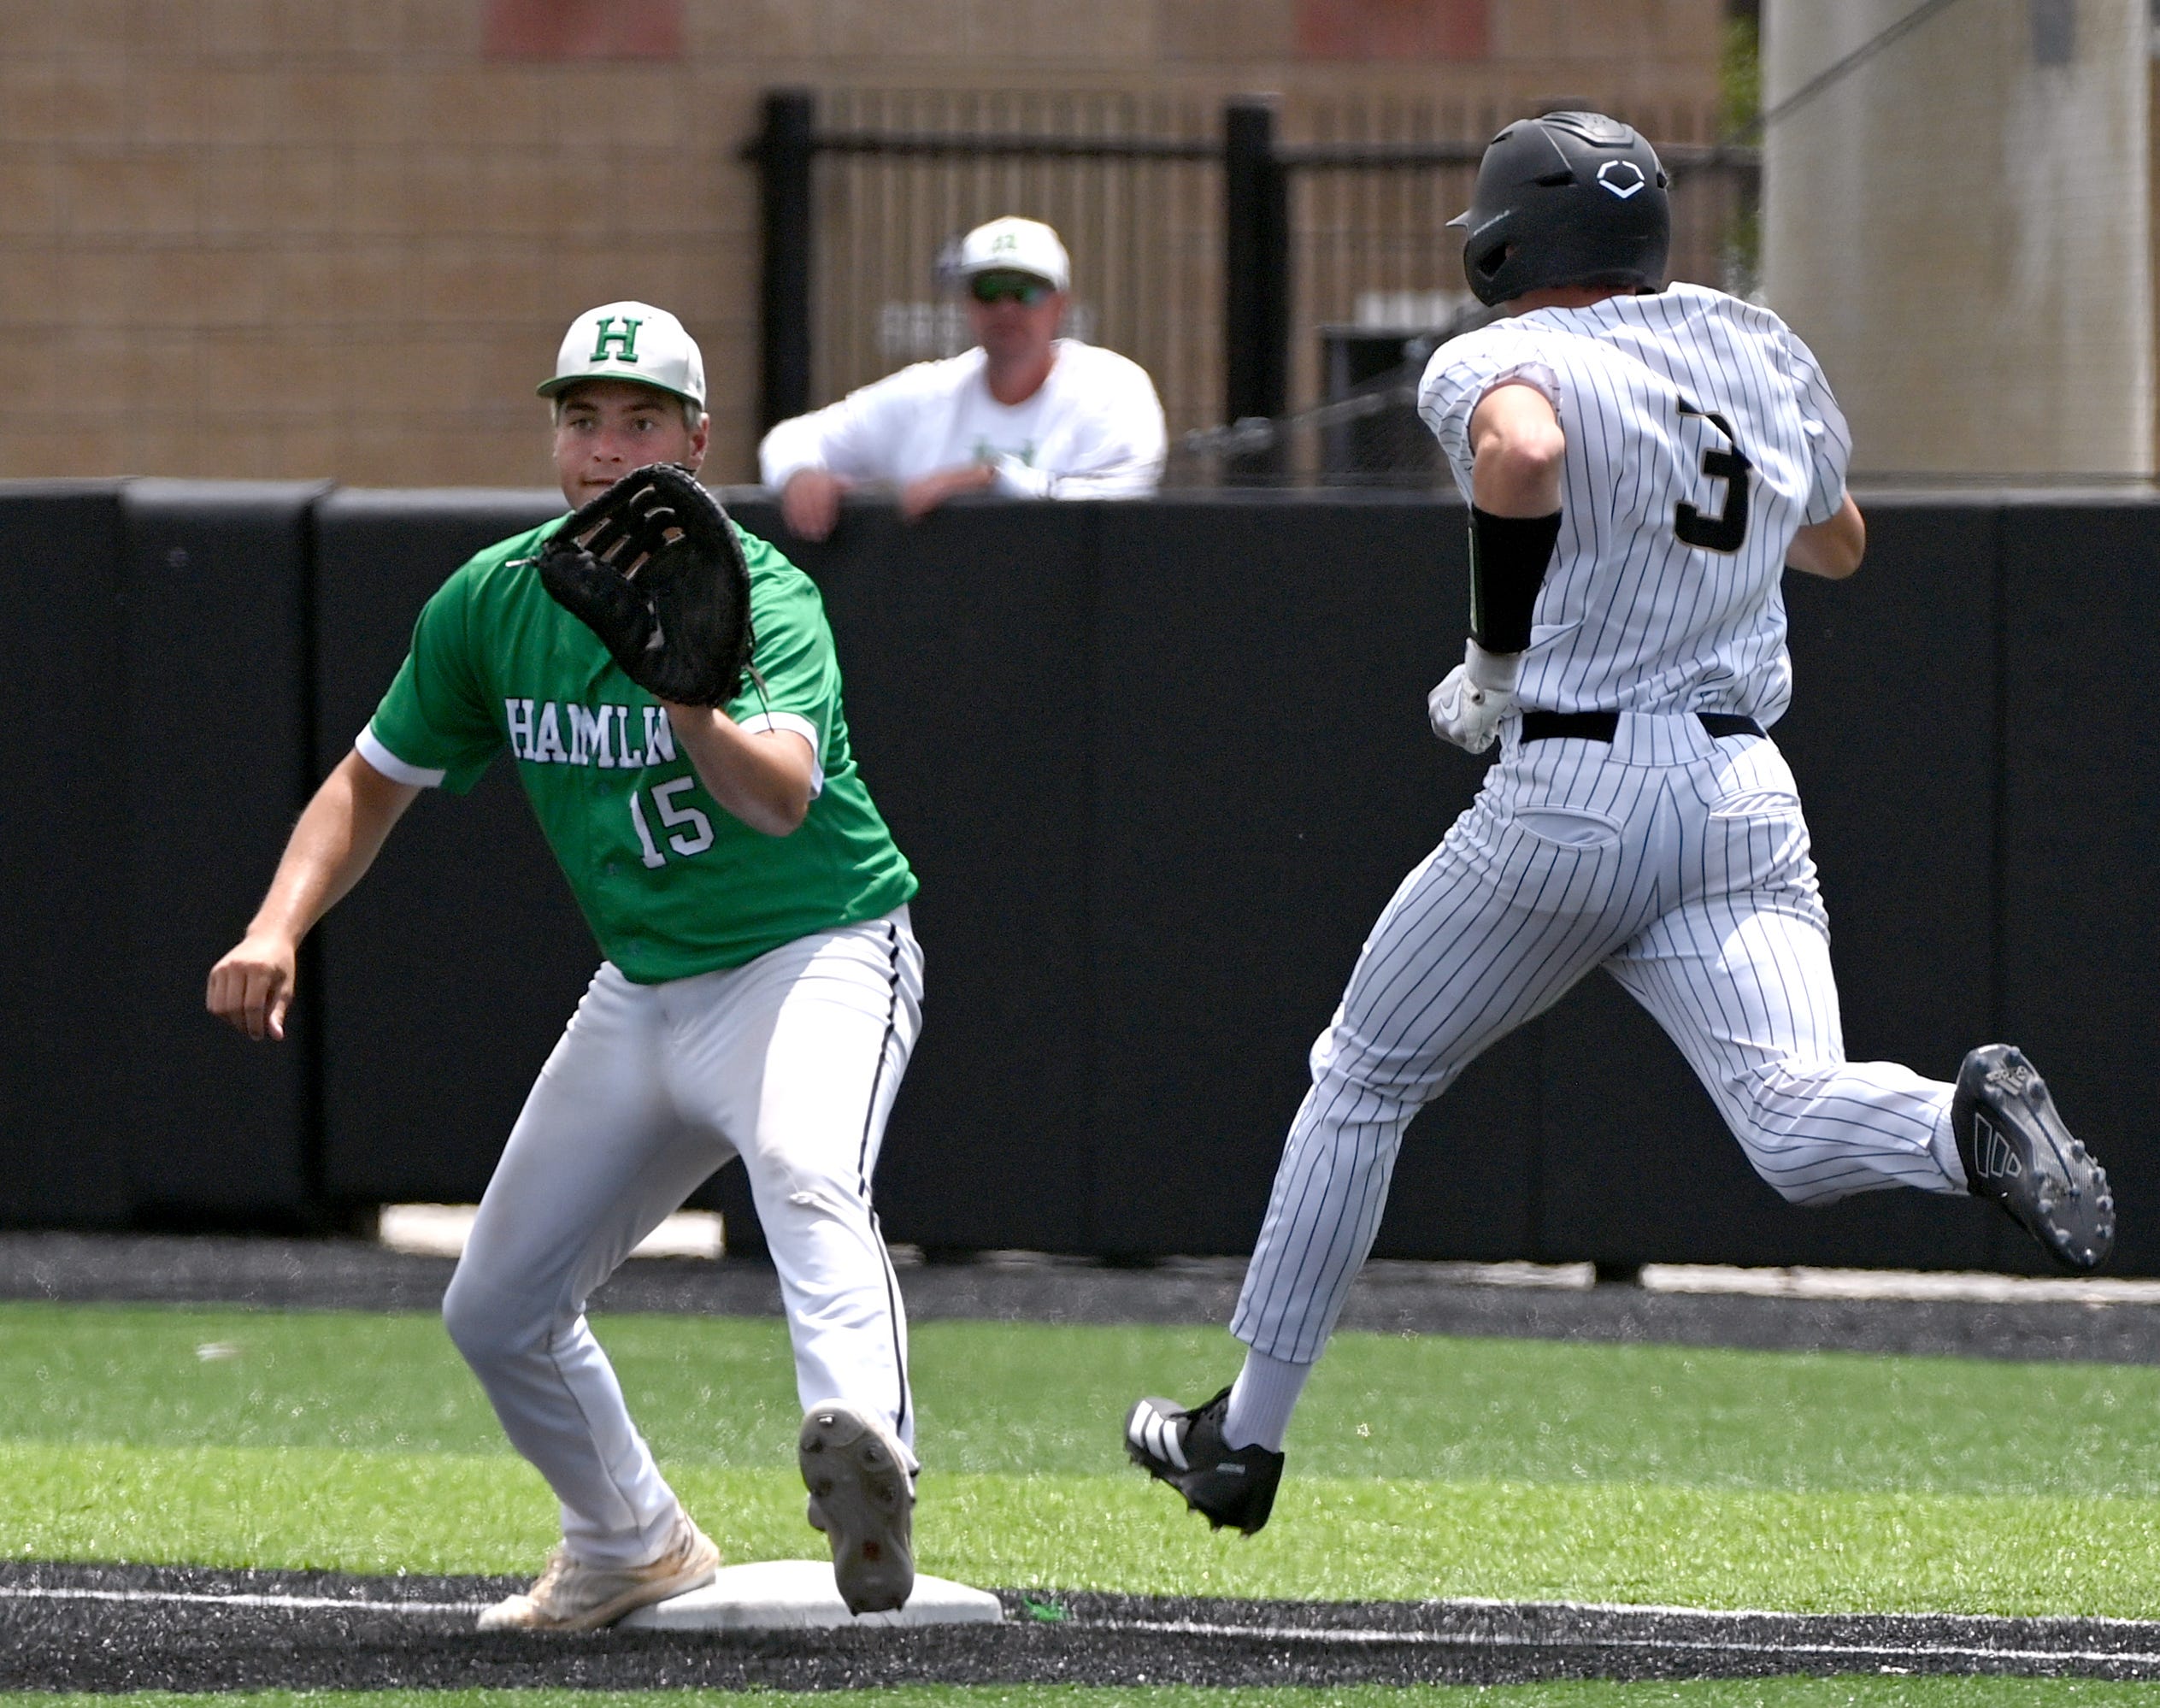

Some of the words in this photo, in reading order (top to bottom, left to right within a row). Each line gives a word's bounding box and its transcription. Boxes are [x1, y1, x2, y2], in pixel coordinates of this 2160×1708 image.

[590, 315, 643, 362] H
[1674, 394, 1753, 556] 3
[629, 775, 715, 869] 15
